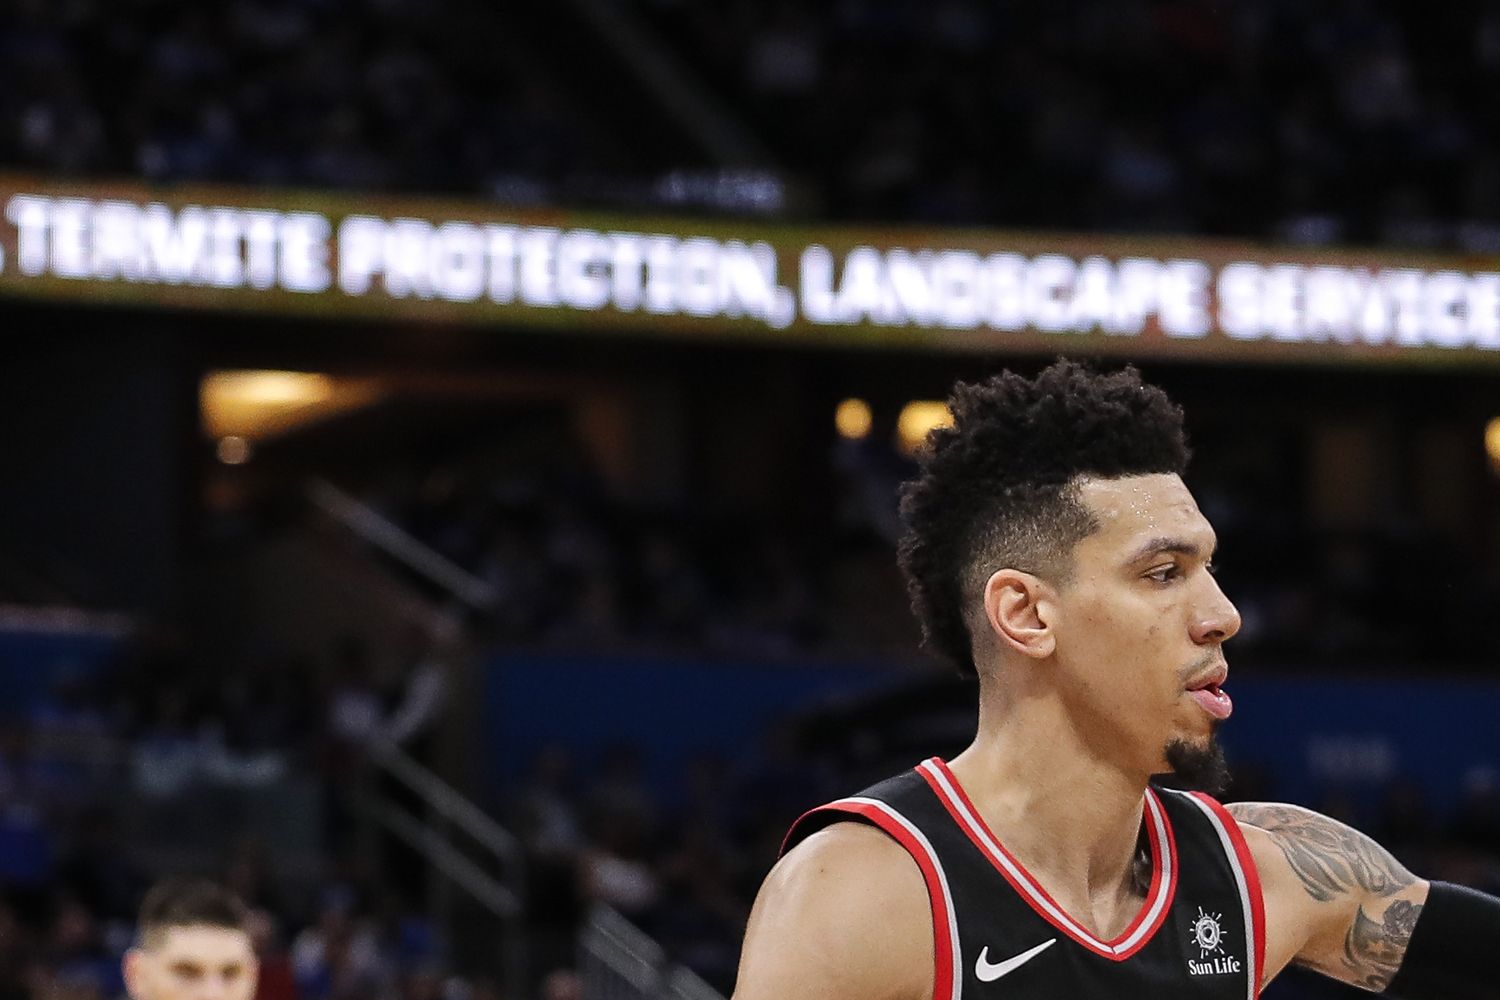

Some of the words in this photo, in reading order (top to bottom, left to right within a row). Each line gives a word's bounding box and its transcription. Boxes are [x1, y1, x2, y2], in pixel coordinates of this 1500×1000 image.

[6, 194, 332, 293] TERMITE
[338, 215, 796, 329] PROTECTION,
[800, 244, 1216, 338] LANDSCAPE
[1188, 959, 1213, 975] Sun
[1214, 956, 1240, 974] Life
